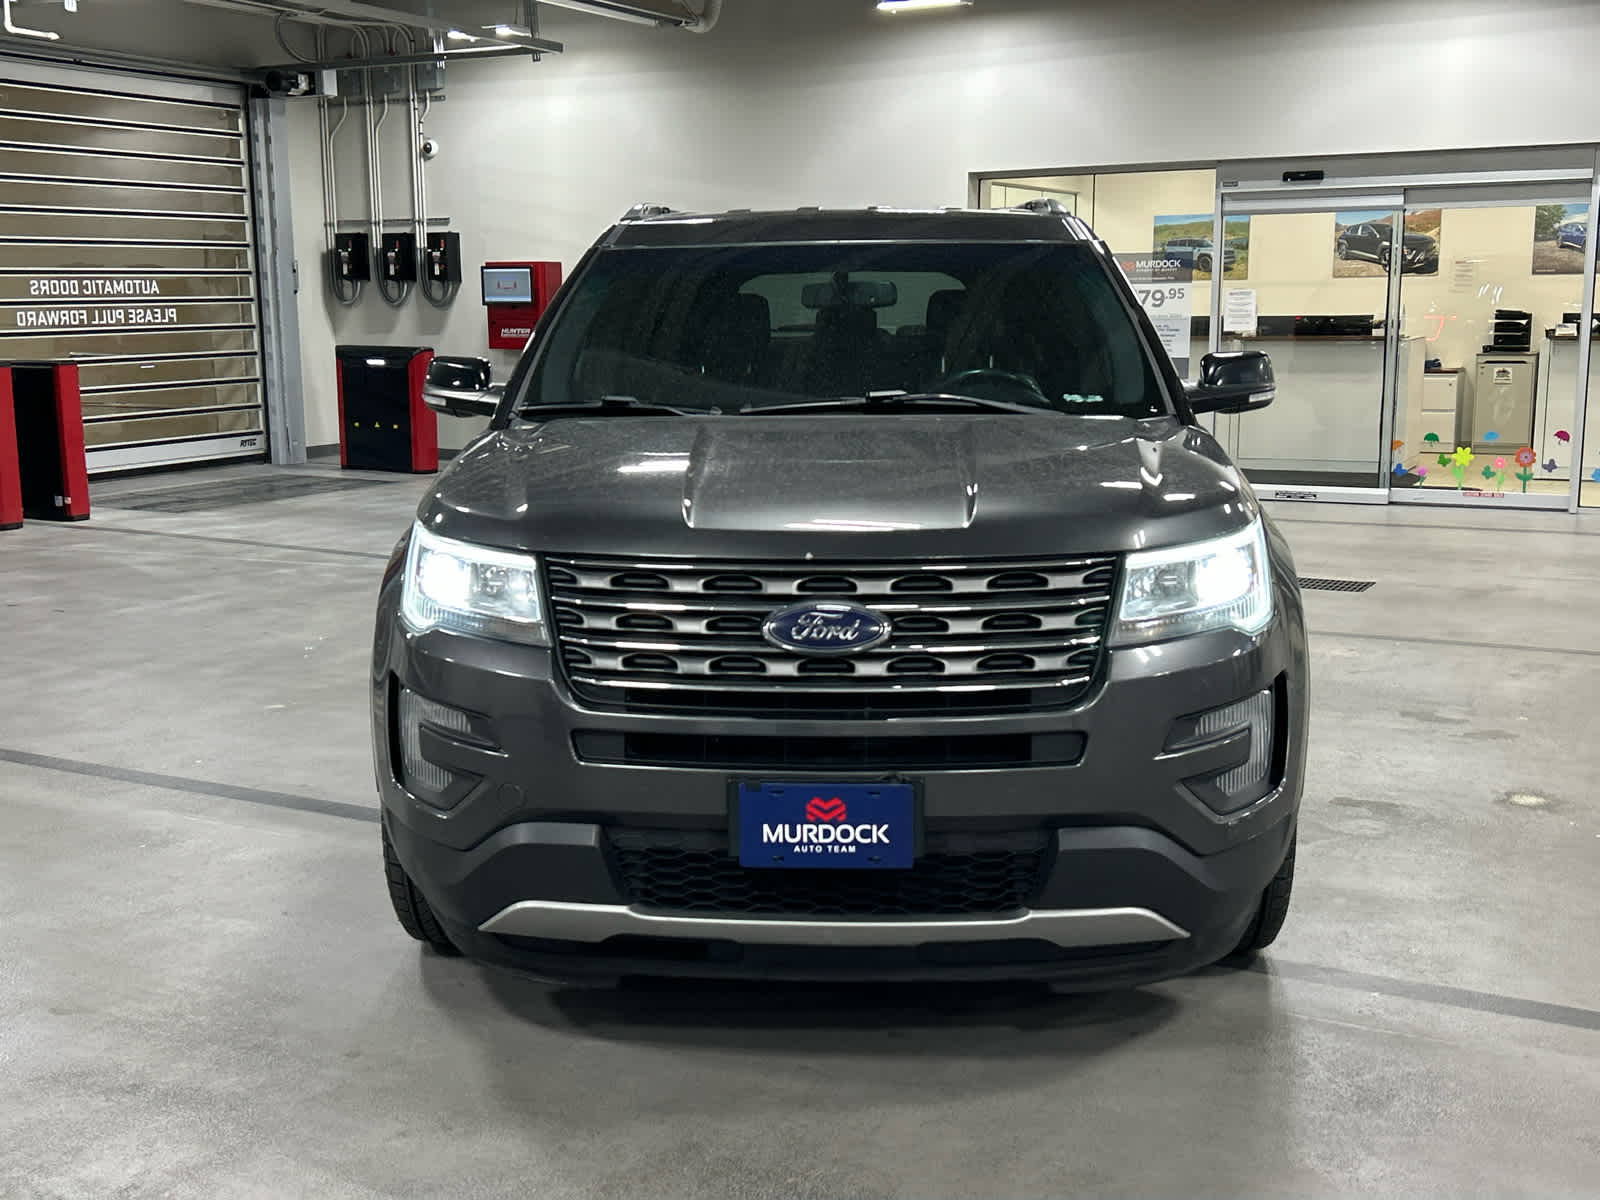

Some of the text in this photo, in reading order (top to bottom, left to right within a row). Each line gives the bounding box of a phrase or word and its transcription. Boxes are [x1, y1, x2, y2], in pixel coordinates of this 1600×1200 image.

[1136, 259, 1181, 268] MURDOCK
[1136, 288, 1184, 307] 79.95
[501, 328, 530, 336] HUNTER
[791, 611, 859, 641] Ford
[762, 823, 890, 844] MURDOCK
[793, 845, 856, 853] AUTO TEAM
